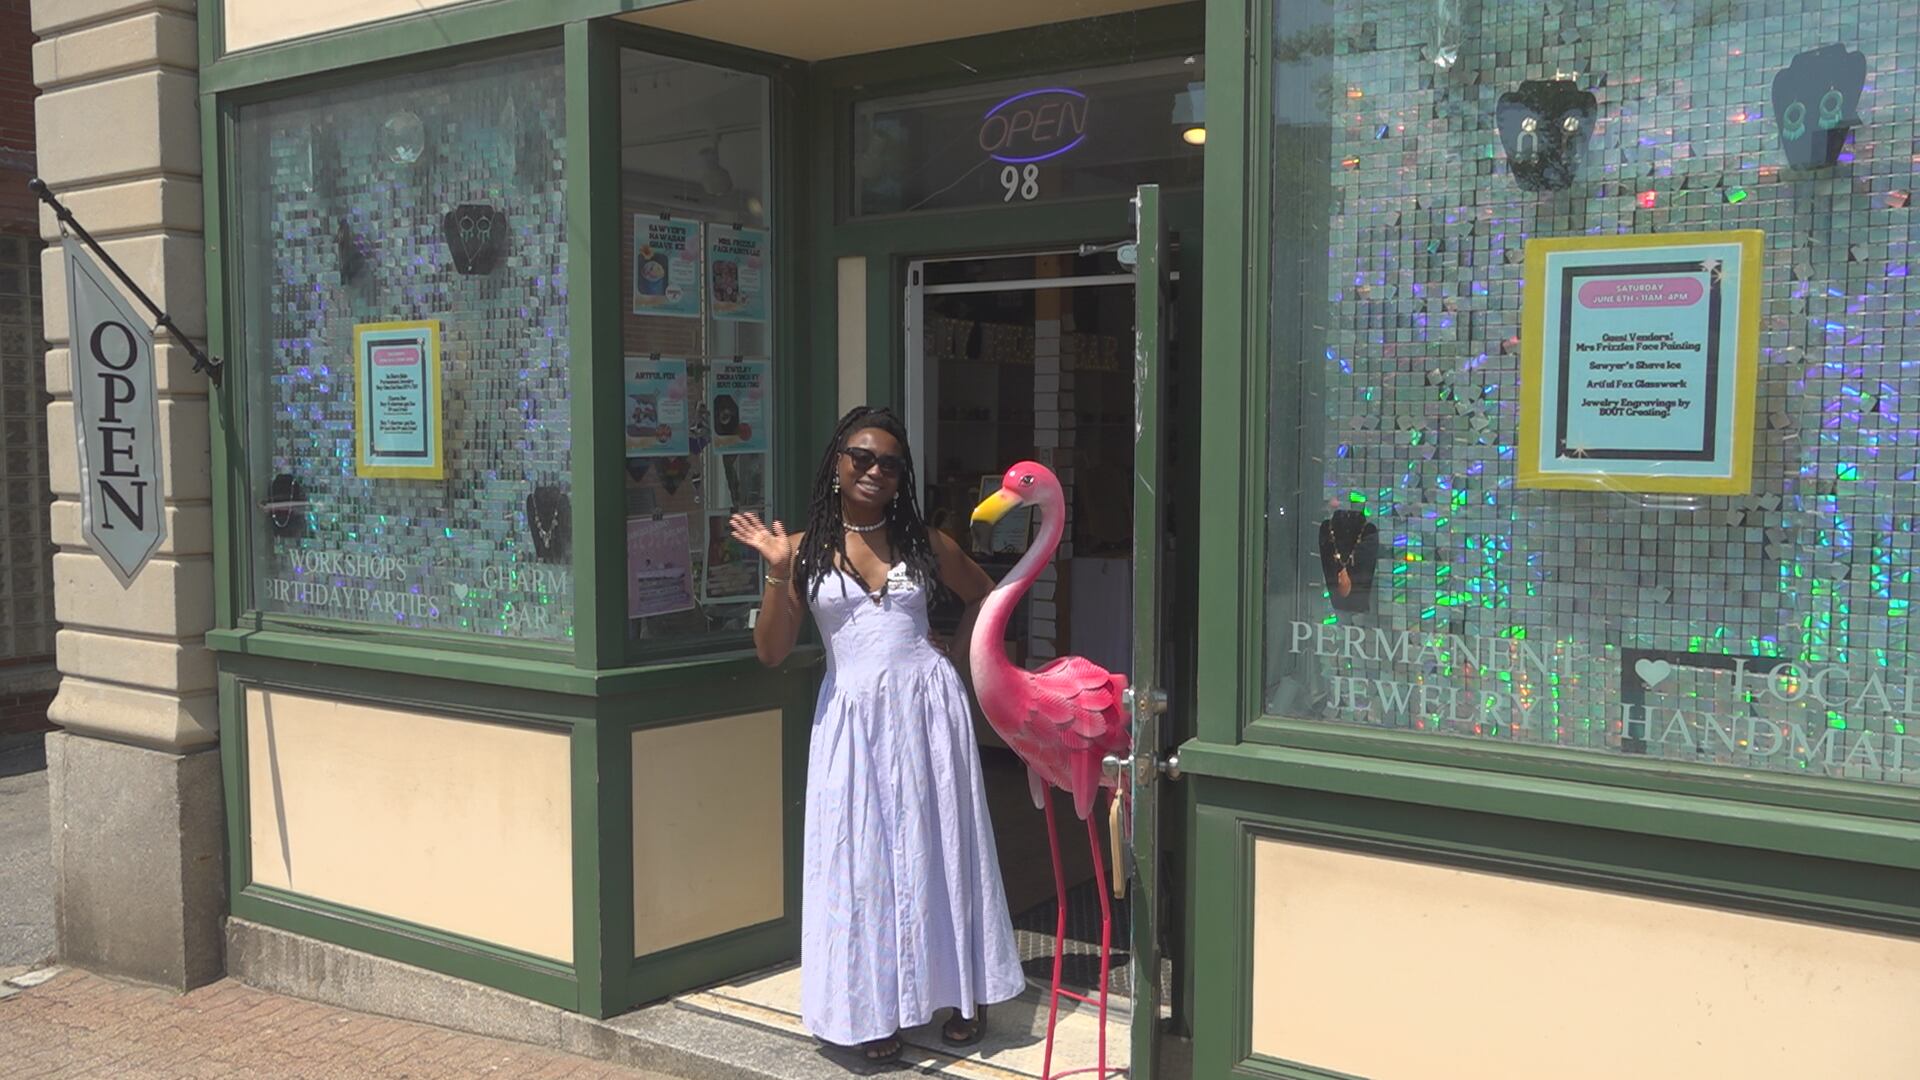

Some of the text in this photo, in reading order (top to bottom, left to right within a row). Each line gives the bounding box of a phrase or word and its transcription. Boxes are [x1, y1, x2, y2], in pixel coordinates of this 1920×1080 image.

[979, 99, 1089, 151] OPEN
[1000, 164, 1039, 202] 98
[1592, 295, 1616, 304] JUNE
[1617, 294, 1634, 303] 6TH
[1616, 283, 1664, 293] SATURDAY
[1576, 340, 1701, 352] Mrs Frizzles Face Painting
[1629, 331, 1674, 342] Vendors!
[1589, 360, 1681, 372] Sawyer's Shave Ice
[1586, 379, 1687, 389] Artful Fox Glasswork
[1581, 399, 1690, 409] Jewelry Engravings by
[1626, 406, 1671, 418] Creating!
[90, 320, 148, 532] OPEN
[288, 548, 407, 581] WORKSHOPS
[482, 564, 568, 595] CHARM
[264, 577, 440, 620] BIRTHDAY PARTIES
[502, 600, 549, 630] BAR
[1289, 620, 1589, 679] PERMANENT
[1326, 675, 1545, 730] JEWELRY
